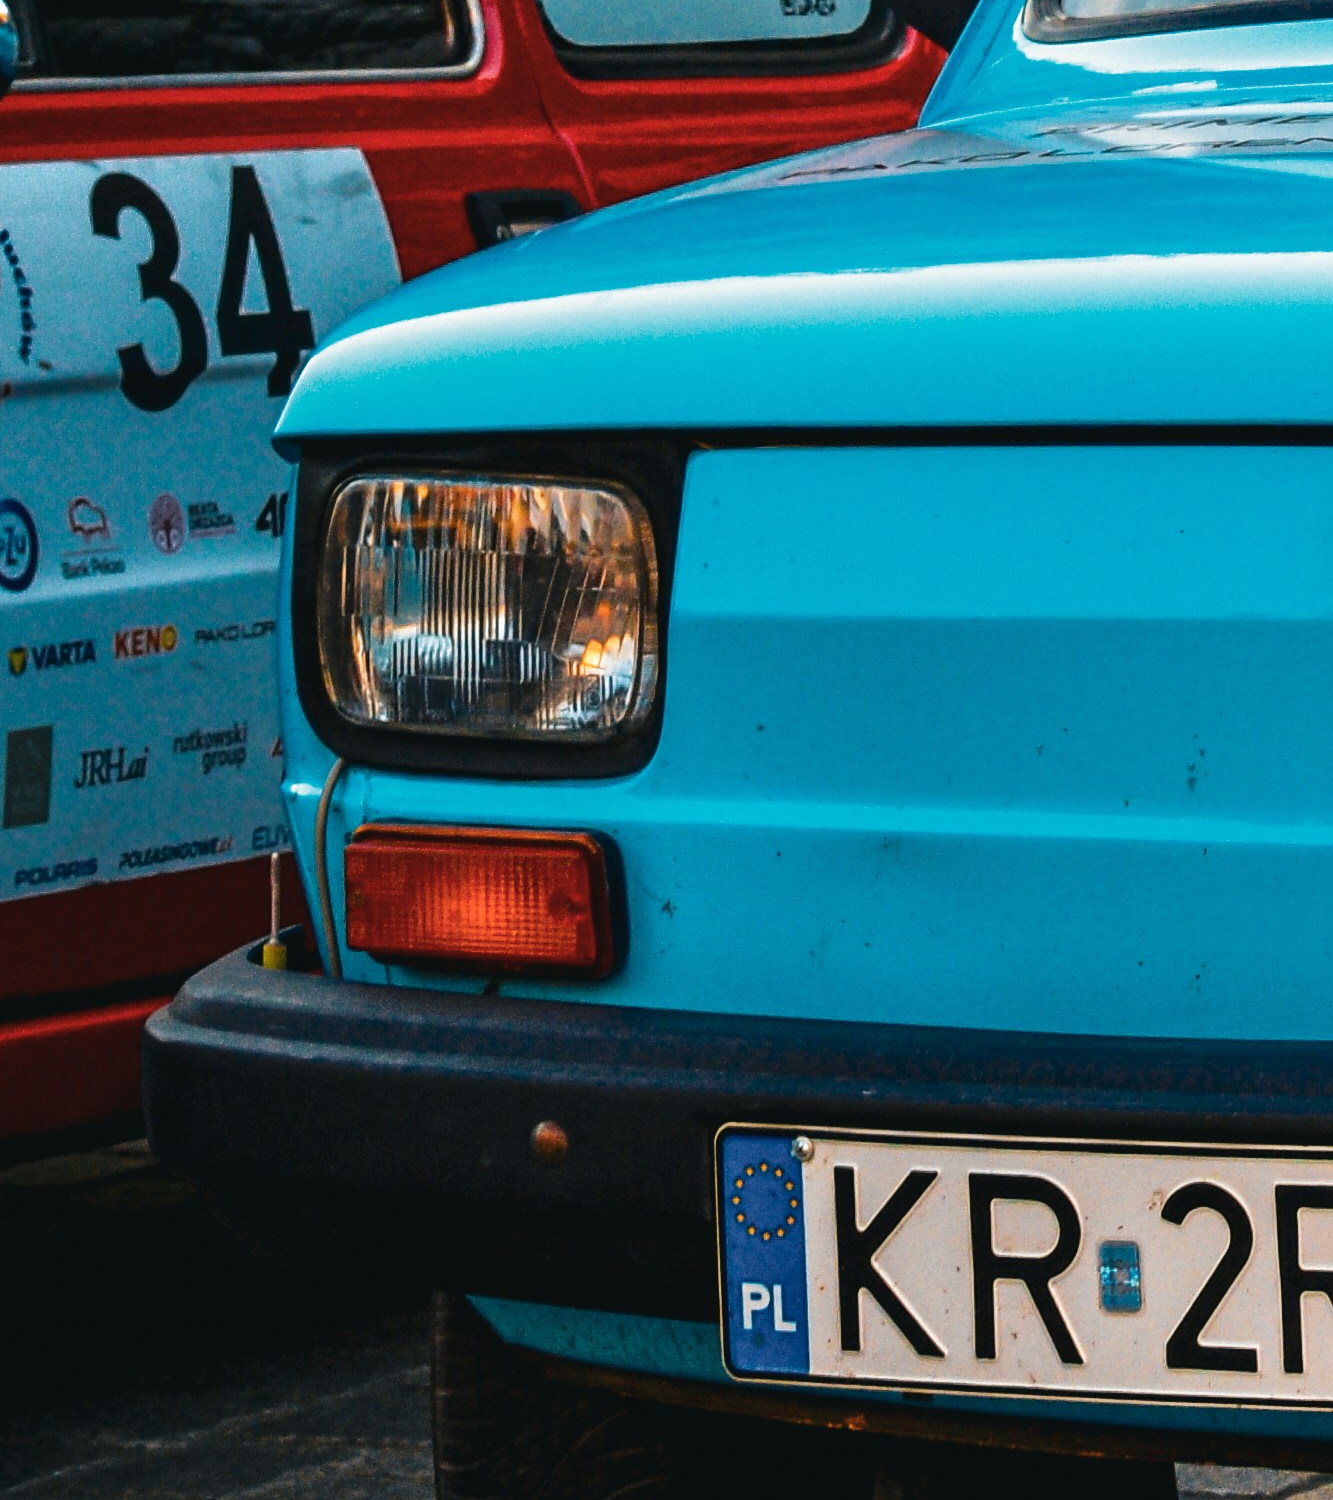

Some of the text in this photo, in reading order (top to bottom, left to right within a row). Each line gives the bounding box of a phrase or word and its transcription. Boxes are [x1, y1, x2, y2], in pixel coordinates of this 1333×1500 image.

[90, 164, 315, 412] 34
[31, 639, 97, 670] VARTA
[740, 1282, 797, 1333] PL
[833, 1165, 1086, 1365] KR
